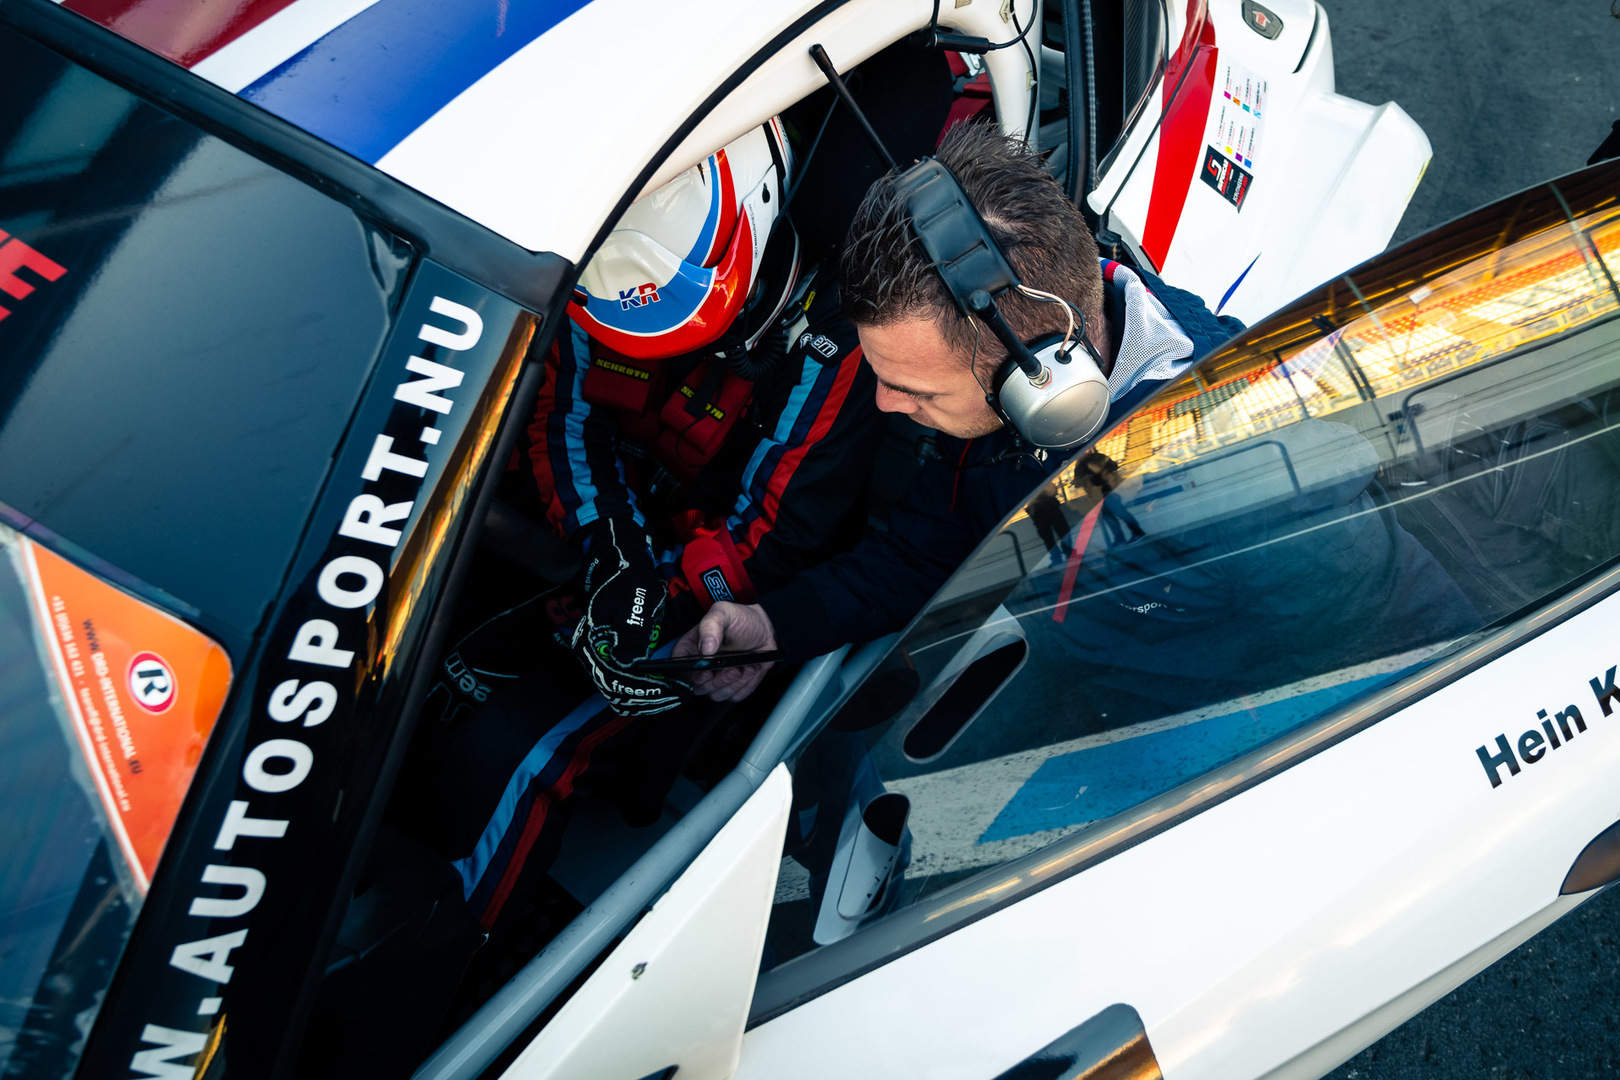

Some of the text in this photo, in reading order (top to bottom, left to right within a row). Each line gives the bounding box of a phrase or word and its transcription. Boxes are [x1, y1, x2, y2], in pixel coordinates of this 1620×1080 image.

[619, 282, 661, 311] KR
[627, 587, 647, 626] freem
[137, 669, 168, 696] R
[611, 680, 662, 697] freem
[1475, 664, 1620, 789] Hein K
